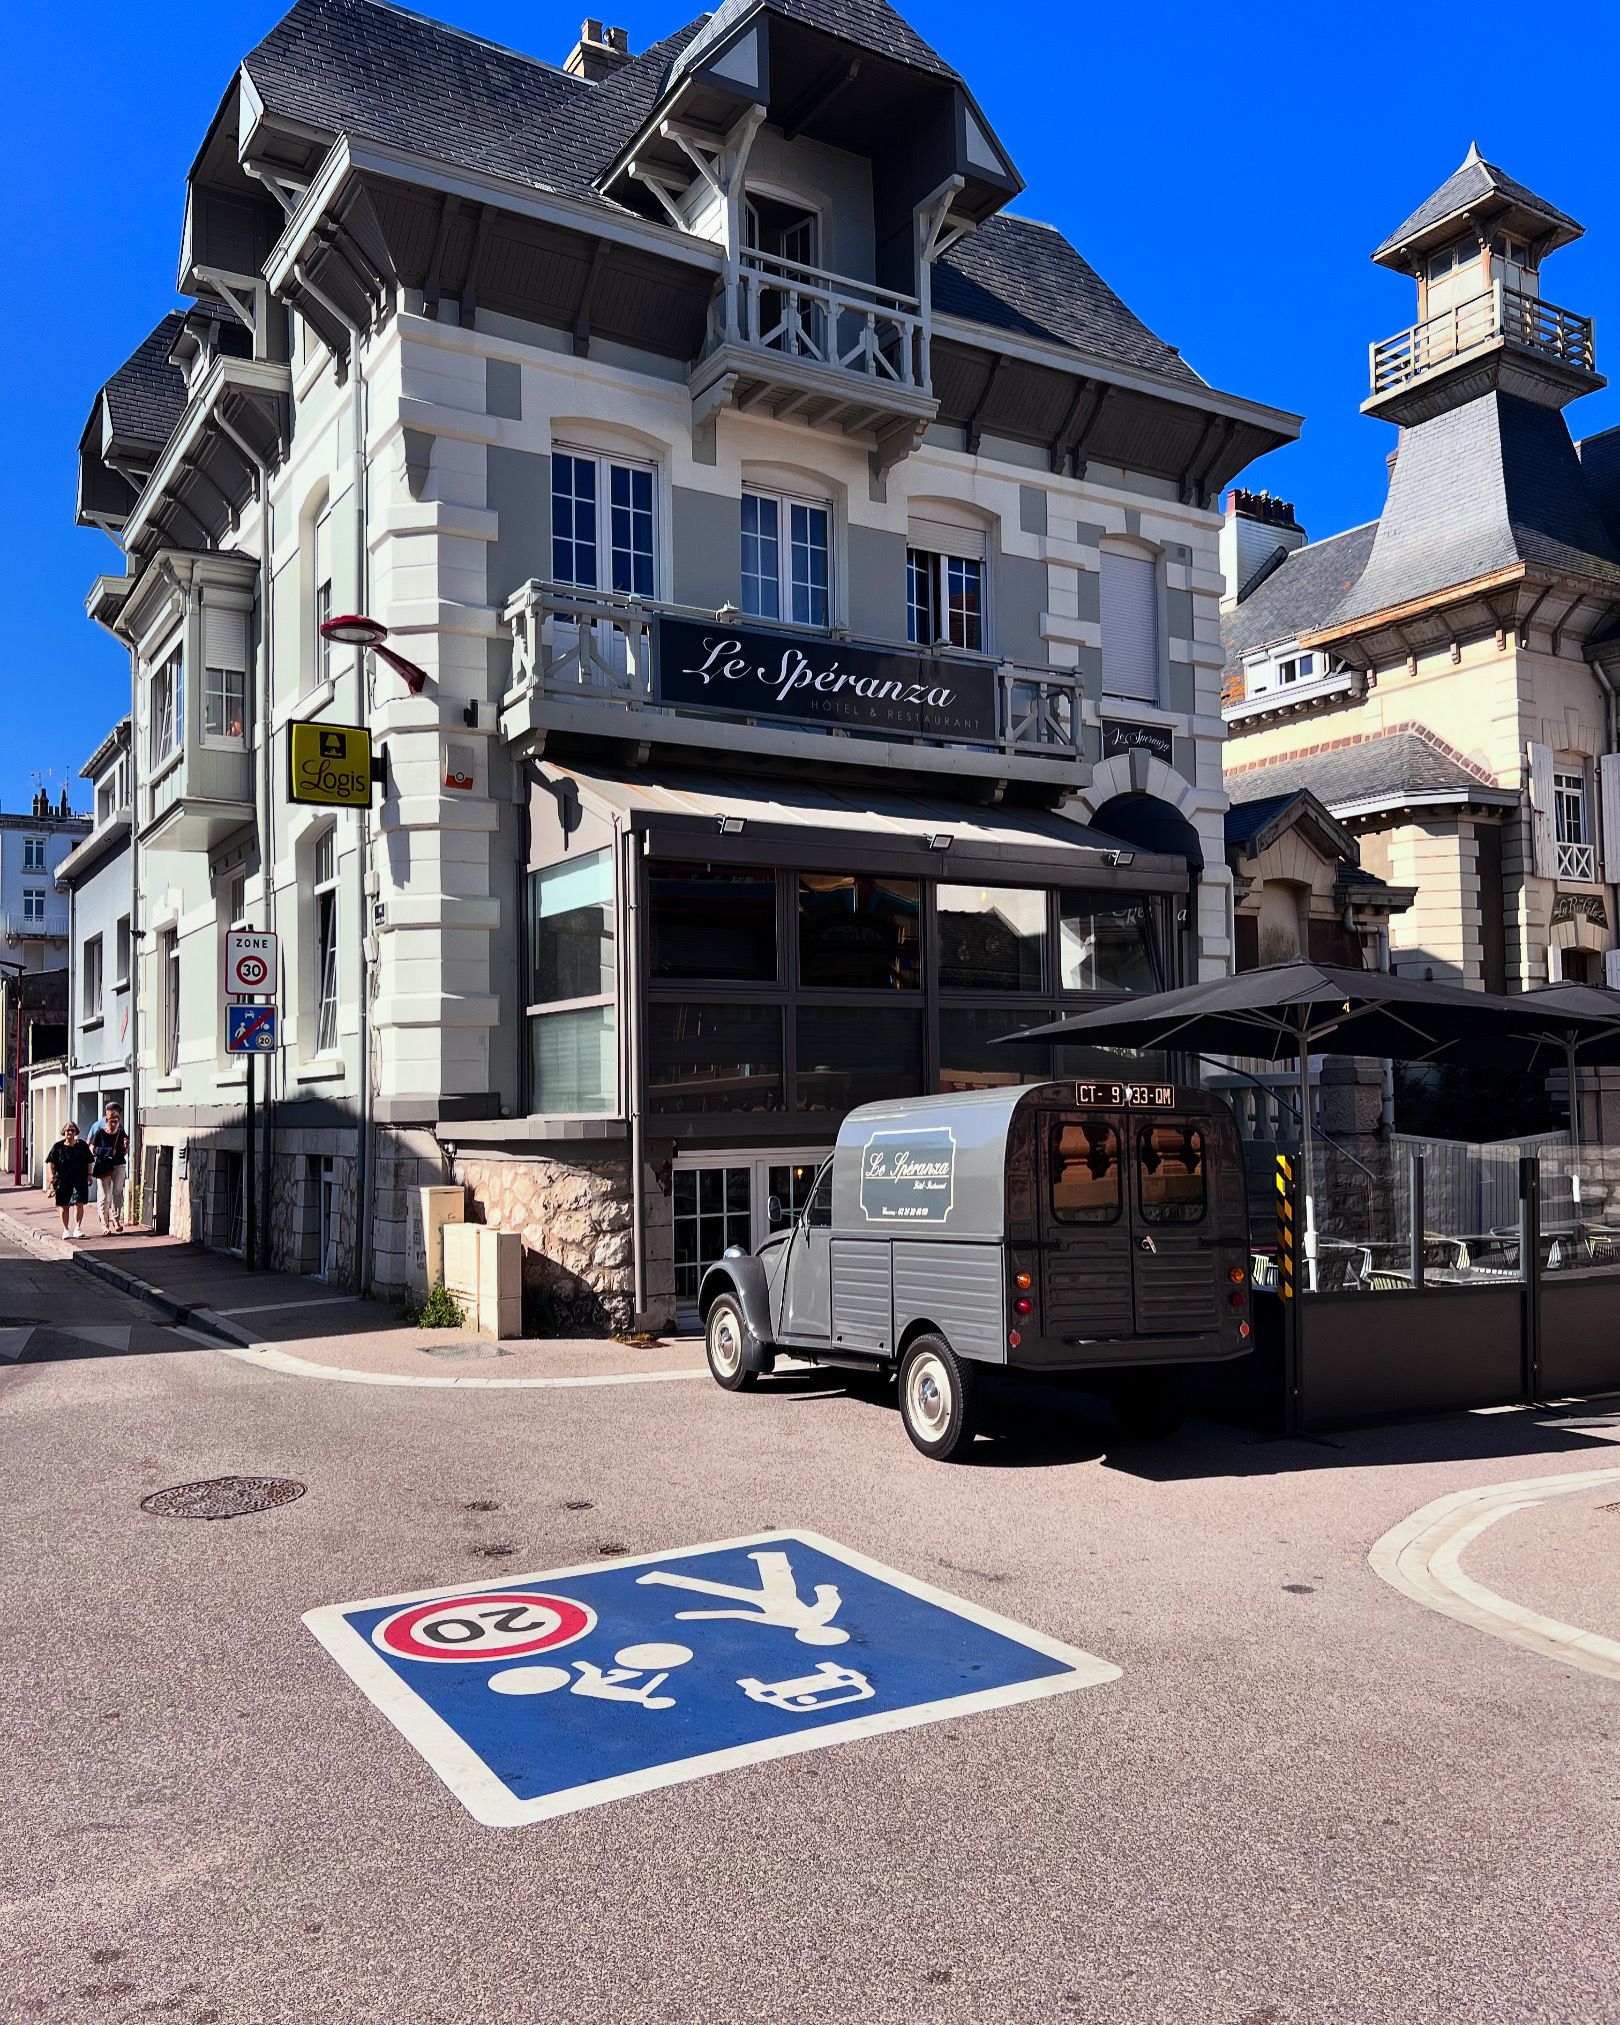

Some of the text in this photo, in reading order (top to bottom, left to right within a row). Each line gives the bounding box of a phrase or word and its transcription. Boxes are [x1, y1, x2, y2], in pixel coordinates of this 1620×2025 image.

[682, 637, 956, 708] Le Spéranza
[811, 699, 980, 730] HÔTEL & RESTAURANT
[300, 759, 366, 798] Logis
[236, 938, 268, 949] ZONE
[242, 963, 262, 978] 30
[259, 1036, 270, 1045] 20
[865, 1152, 886, 1177] Le
[422, 1606, 546, 1644] 20
